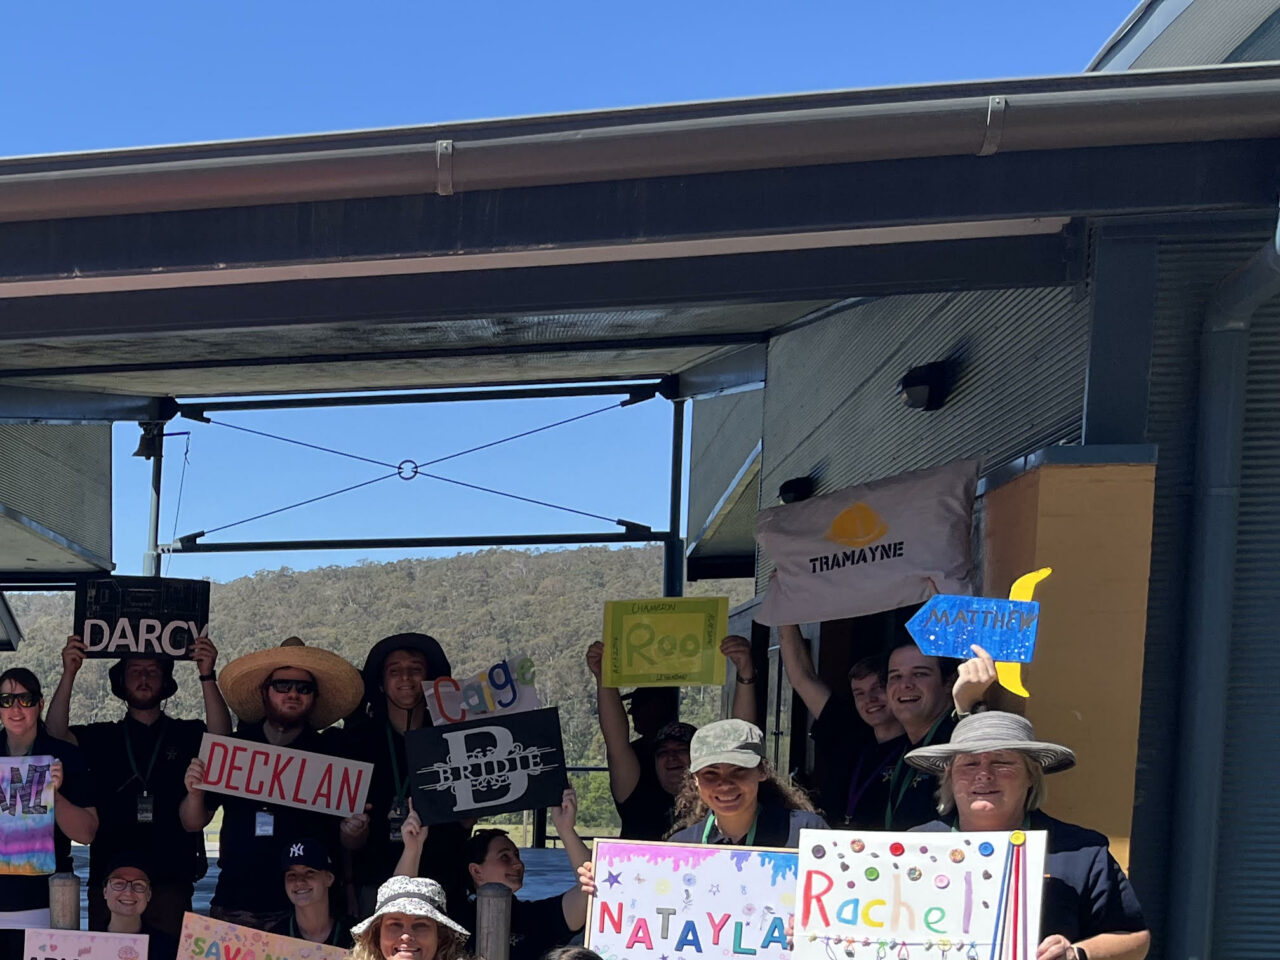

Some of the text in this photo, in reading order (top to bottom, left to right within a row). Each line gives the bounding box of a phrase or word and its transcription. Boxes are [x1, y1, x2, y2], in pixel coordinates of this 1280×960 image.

[809, 541, 904, 573] TRAMAYNE
[83, 617, 208, 656] DARCY
[923, 609, 1038, 631] MATTHEW
[627, 623, 700, 667] Roo
[433, 658, 535, 723] Caige
[202, 741, 364, 813] DECKLAN
[438, 752, 544, 785] BRIDIE
[801, 870, 973, 934] Rachel
[599, 901, 789, 955] NATAYLA
